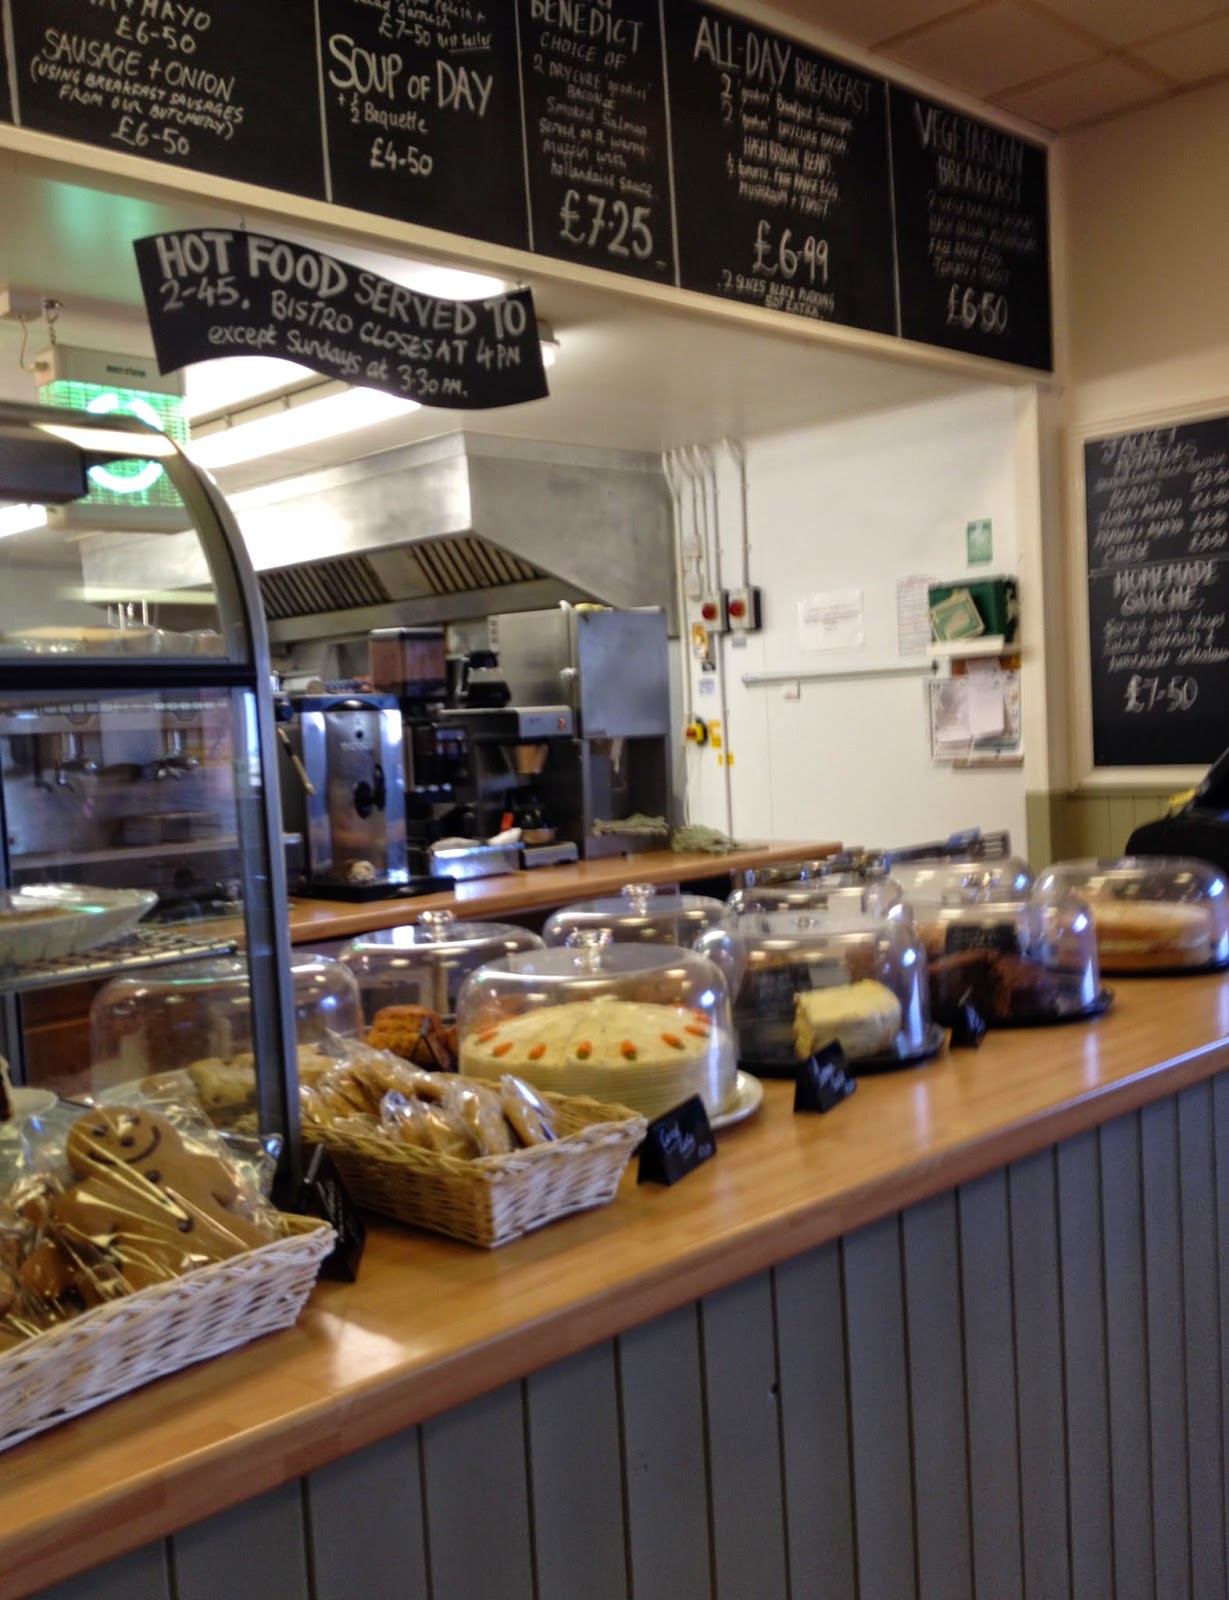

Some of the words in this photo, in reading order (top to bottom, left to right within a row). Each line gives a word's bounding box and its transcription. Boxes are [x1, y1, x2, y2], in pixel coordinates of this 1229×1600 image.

[141, 0, 212, 31] MAYO
[531, 0, 644, 54] BENEDICT
[41, 27, 143, 77] SAUSAGE
[164, 61, 236, 101] ONION
[328, 34, 404, 101] SOUP
[407, 74, 431, 101] OF
[436, 59, 494, 118] DAY
[533, 52, 545, 76] 2
[540, 31, 599, 62] CHOICE
[604, 50, 627, 70] OF
[59, 84, 104, 107] FROM
[84, 71, 167, 100] BREAKFAST
[170, 91, 244, 124] SAUSAGES
[795, 56, 873, 115] BREAKFAST
[155, 231, 234, 281] HOT
[247, 235, 349, 299] FOOD
[353, 272, 478, 337] SERVED
[484, 296, 527, 342] TO
[207, 323, 278, 351] except
[286, 327, 363, 378] Sundays
[366, 358, 391, 382] at
[271, 288, 355, 335] BISTRO
[434, 338, 470, 366] AT
[1113, 557, 1219, 599] HOMEMADE
